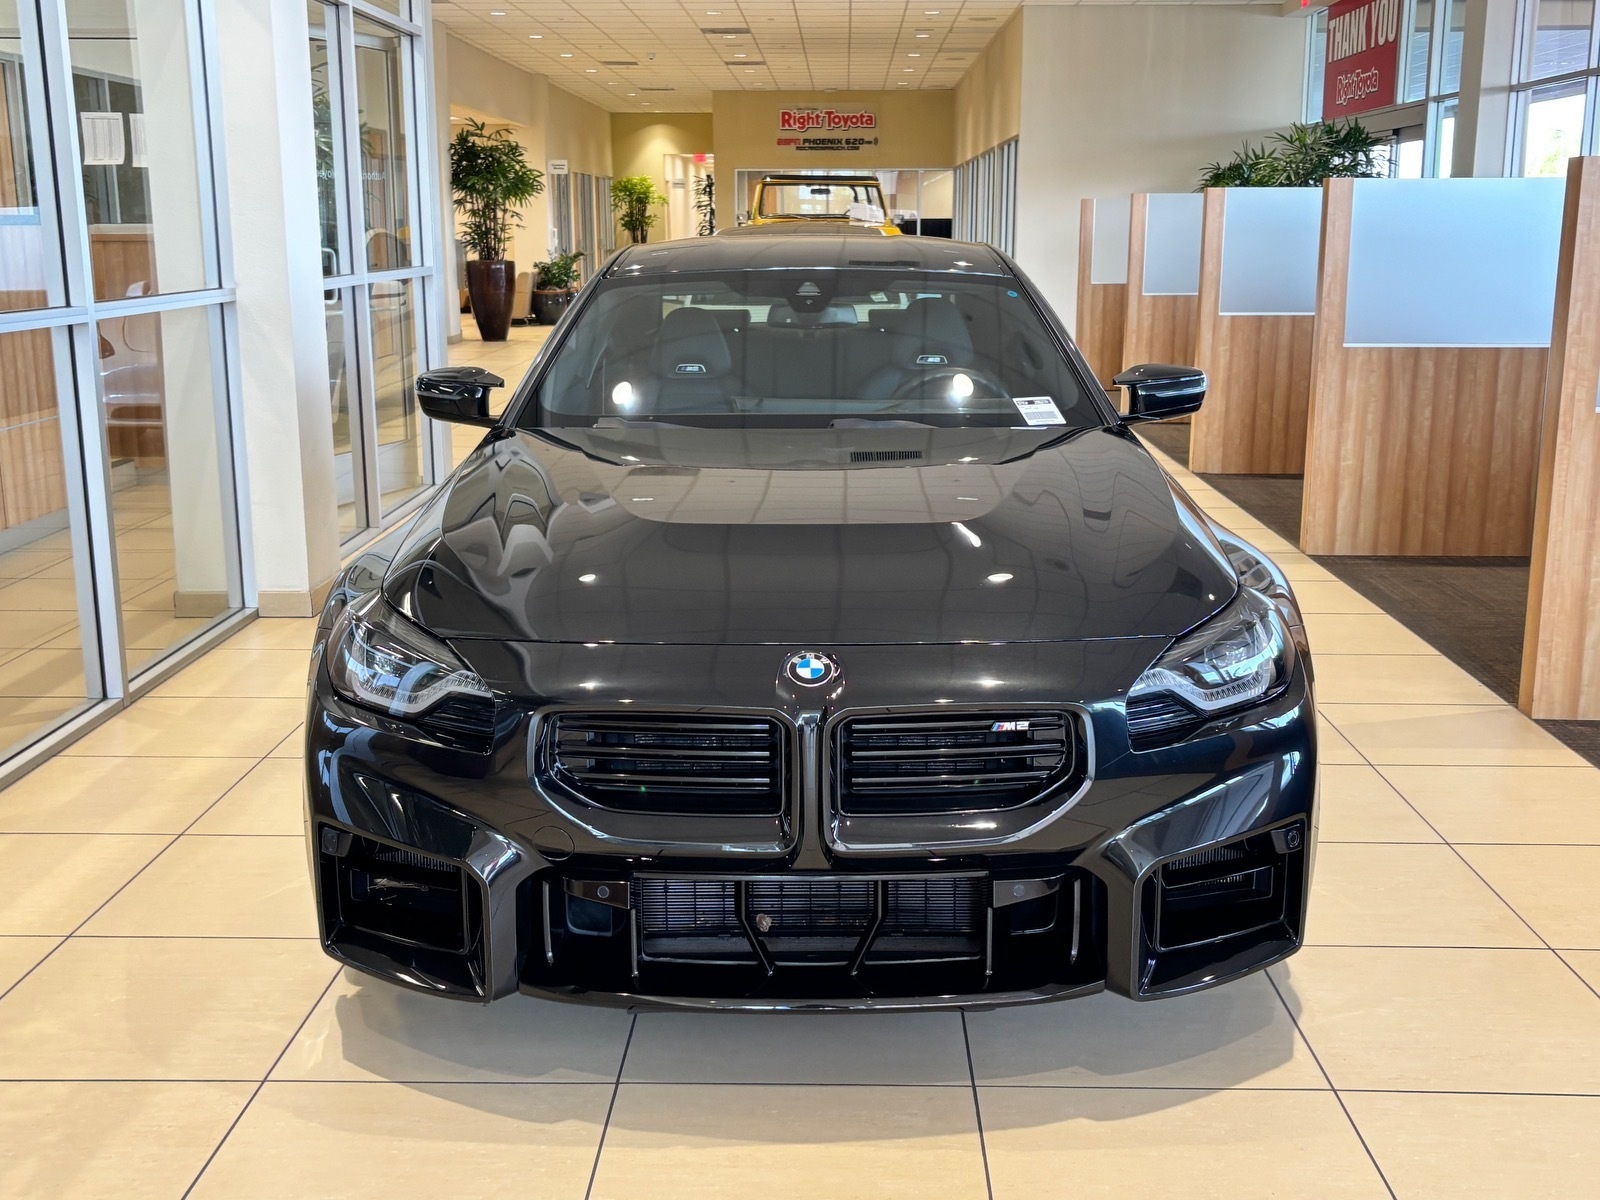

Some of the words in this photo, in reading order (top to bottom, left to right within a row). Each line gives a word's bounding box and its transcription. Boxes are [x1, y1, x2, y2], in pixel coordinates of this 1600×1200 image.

[1328, 4, 1368, 63] THANK
[1371, 0, 1398, 48] YOU
[1336, 73, 1356, 105] Right
[1354, 66, 1379, 99] Toyota
[780, 110, 822, 131] Right
[823, 109, 875, 130] Toyota
[776, 138, 801, 146] ESPN
[802, 138, 843, 146] PHOENIX
[792, 653, 830, 664] BMW
